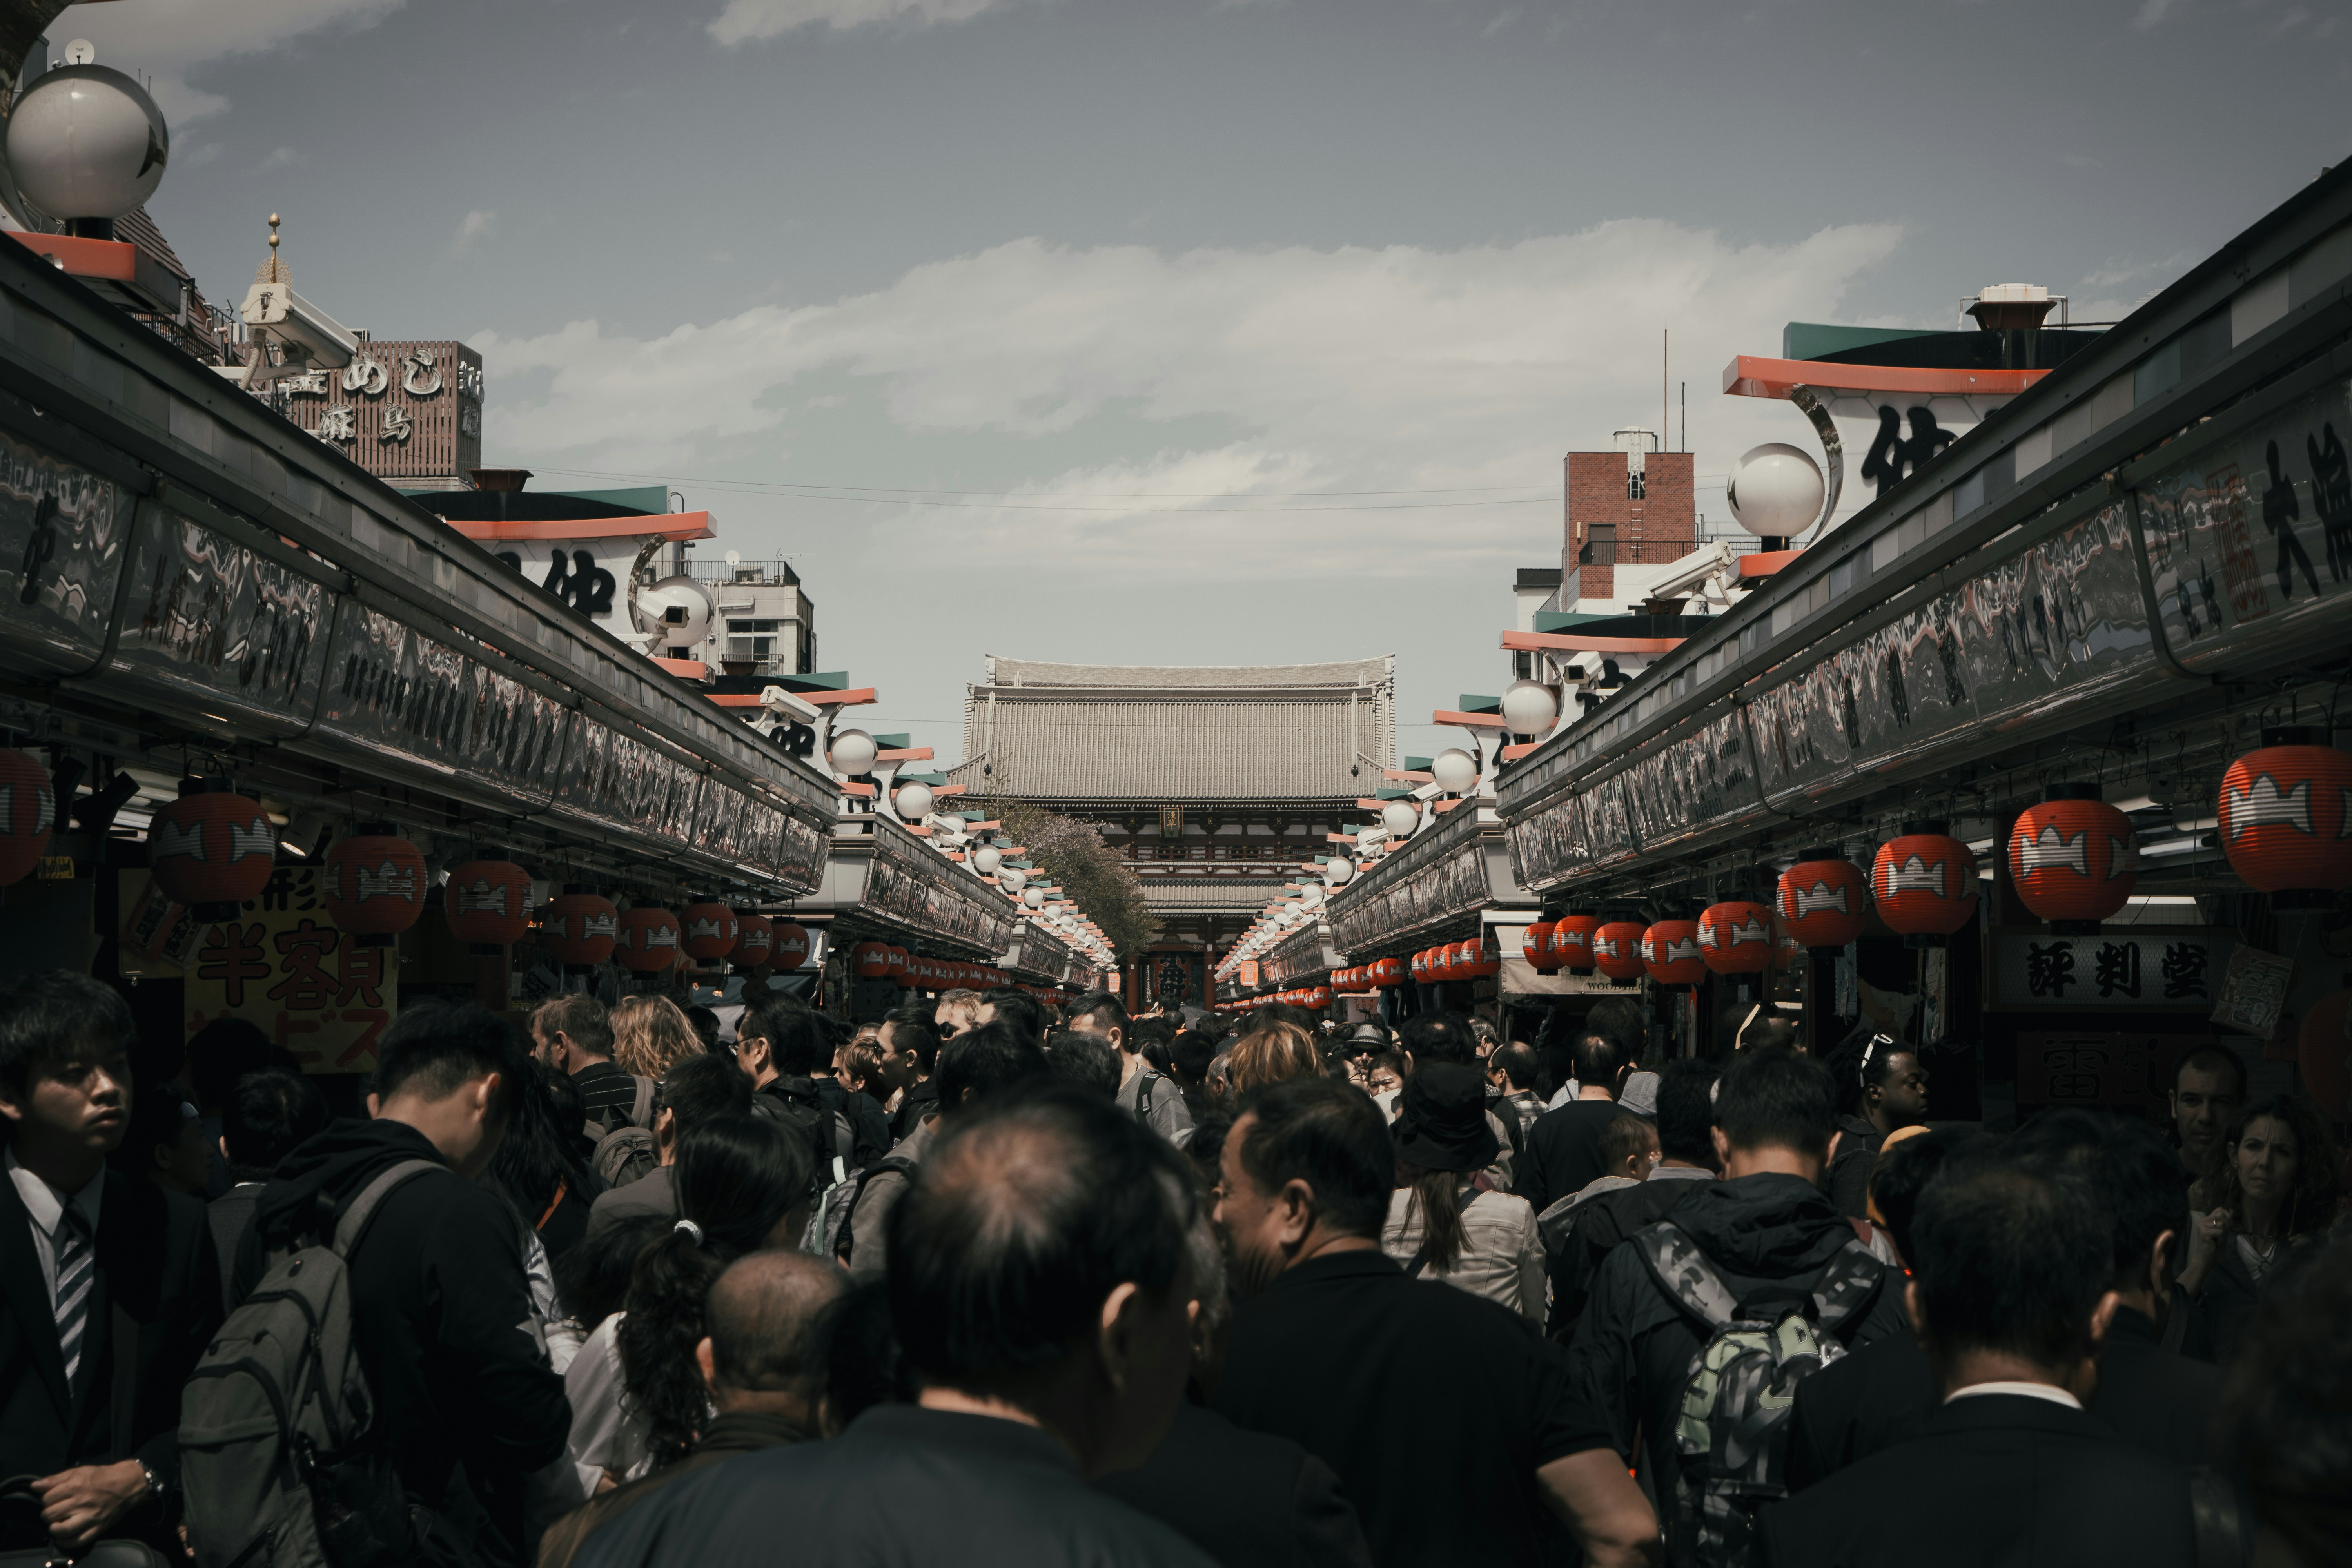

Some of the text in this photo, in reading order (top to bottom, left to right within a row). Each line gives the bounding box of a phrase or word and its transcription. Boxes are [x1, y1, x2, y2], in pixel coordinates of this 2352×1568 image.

[2027, 941, 2207, 999] 評判堂
[187, 1009, 389, 1068] ビス
